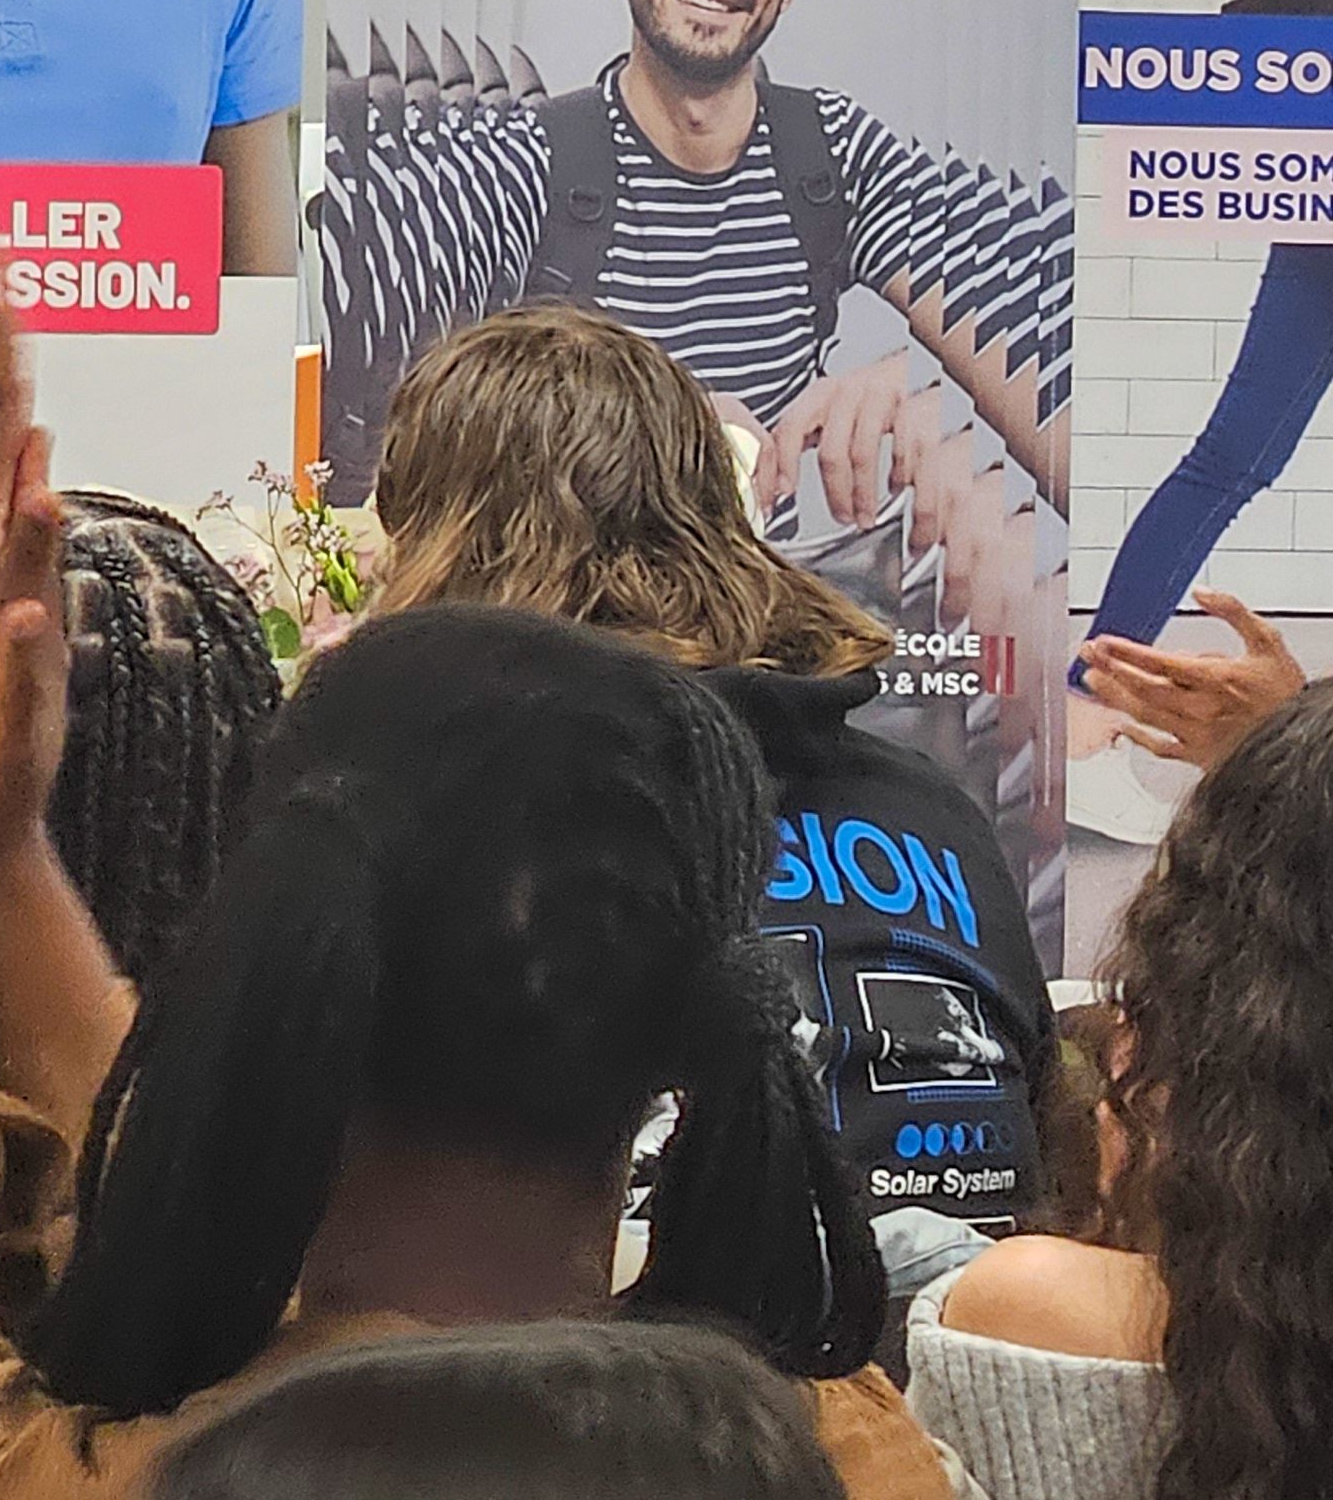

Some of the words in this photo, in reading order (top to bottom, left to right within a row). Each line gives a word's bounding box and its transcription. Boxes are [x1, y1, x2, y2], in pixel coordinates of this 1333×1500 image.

[1084, 46, 1242, 93] NOUS
[1129, 149, 1242, 182] NOUS
[1127, 189, 1205, 220] DES
[5, 259, 191, 311] SSION.
[894, 628, 981, 658] ÉCOLE
[894, 671, 915, 695] &
[921, 671, 981, 695] MSC
[870, 1168, 939, 1197] Solar
[942, 1167, 1016, 1200] System
